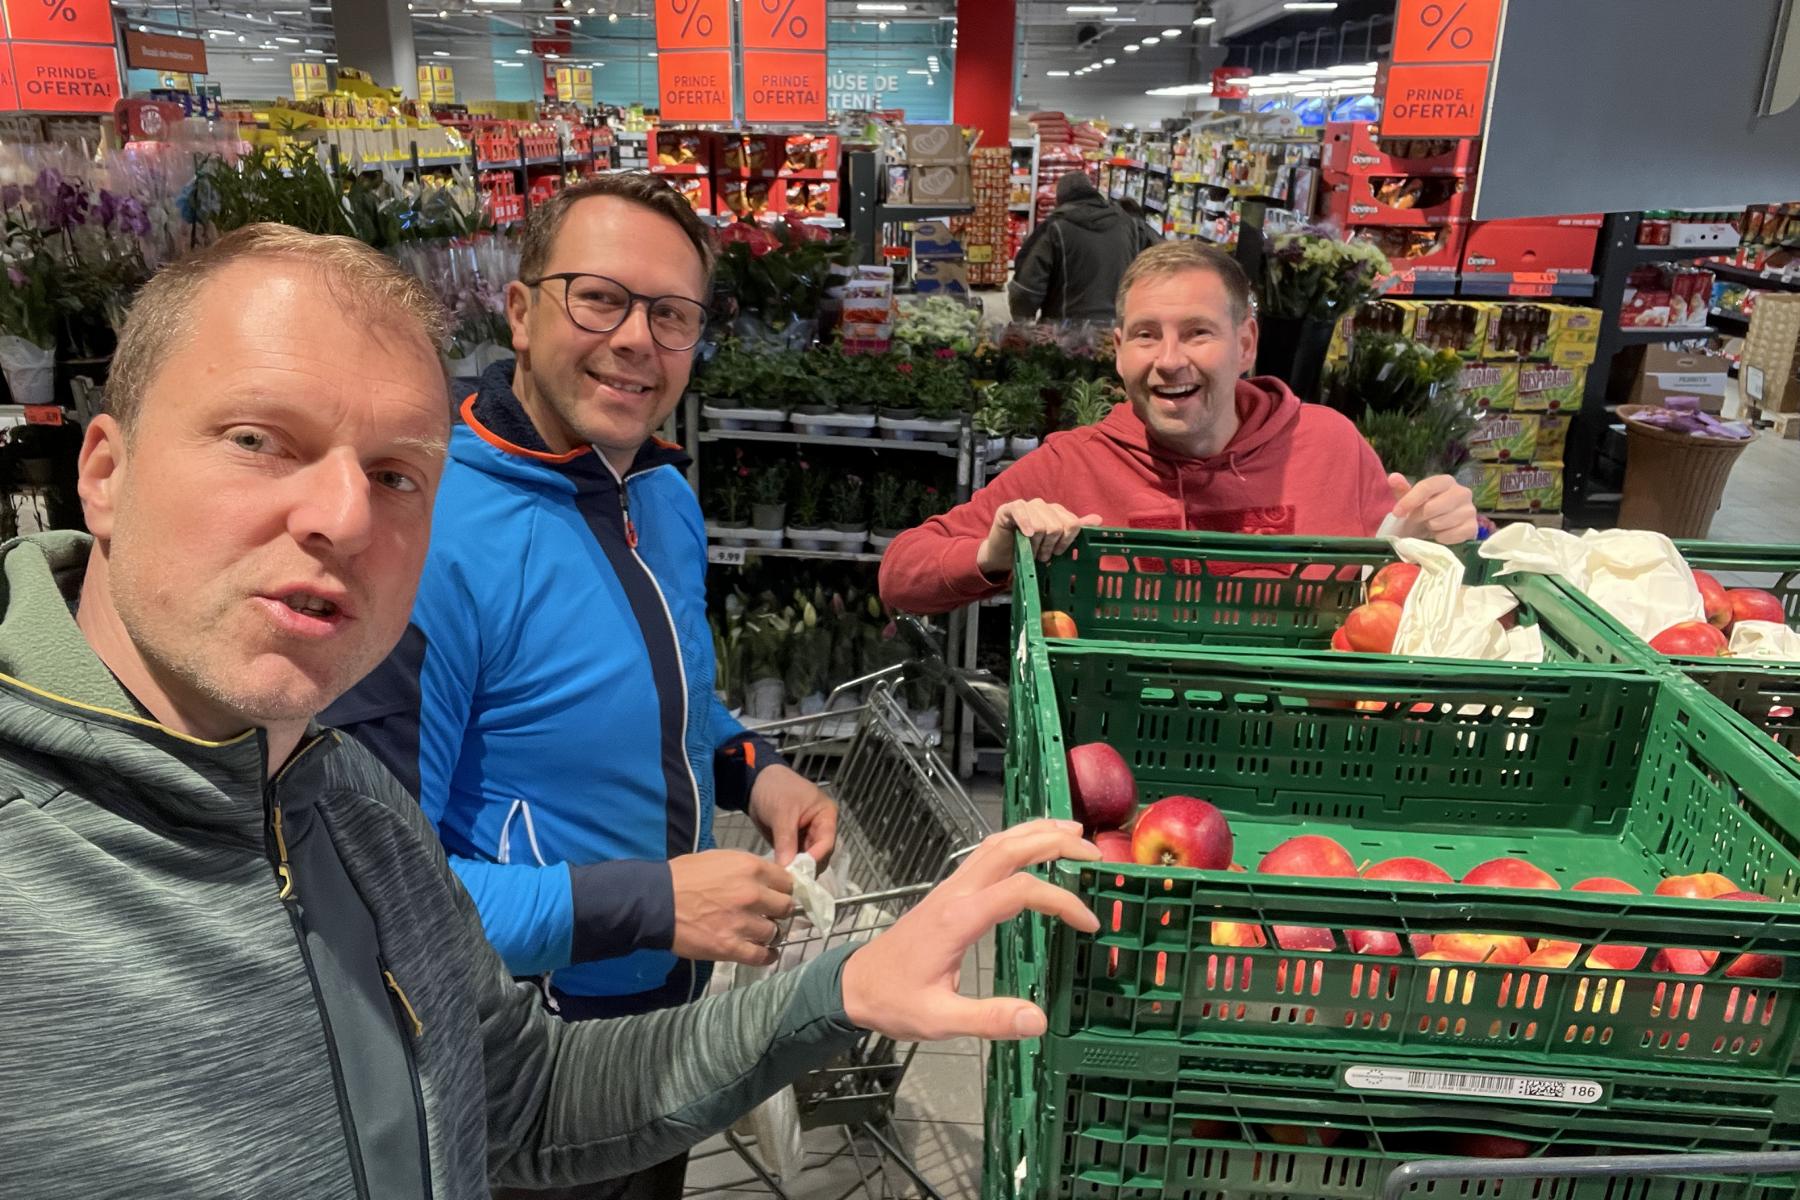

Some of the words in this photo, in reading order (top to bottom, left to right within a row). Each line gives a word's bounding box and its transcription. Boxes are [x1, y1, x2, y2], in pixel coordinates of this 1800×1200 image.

[671, 0, 712, 38] %
[761, 0, 807, 38] %
[1420, 3, 1474, 51] %
[36, 66, 97, 79] PRINDE
[674, 75, 717, 87] PRINDE
[762, 75, 809, 87] PRINDE
[875, 75, 899, 91] DE
[27, 80, 112, 97] OFERTA!
[1406, 88, 1464, 100] PRINDE
[666, 91, 726, 104] OFERTA!
[753, 91, 819, 104] OFERTA!
[827, 93, 882, 110] TENIE
[1392, 104, 1475, 118] OFERTA!
[1570, 1085, 1596, 1097] 186
